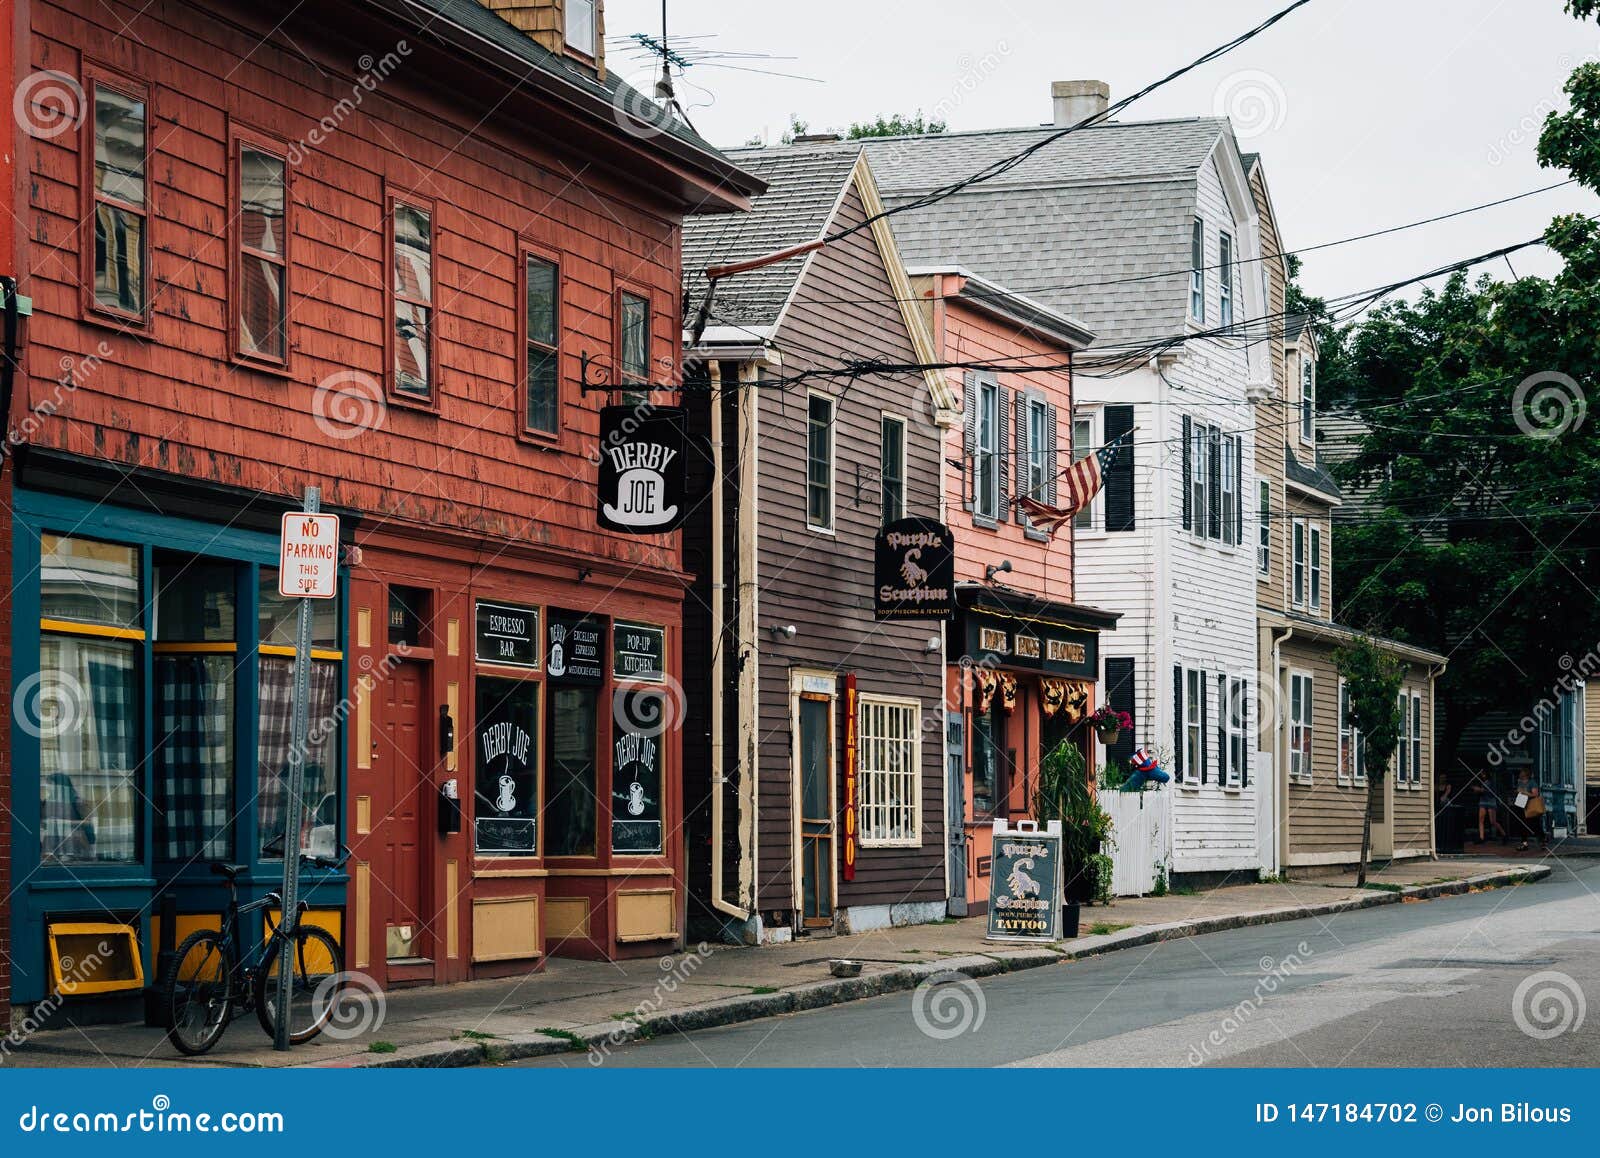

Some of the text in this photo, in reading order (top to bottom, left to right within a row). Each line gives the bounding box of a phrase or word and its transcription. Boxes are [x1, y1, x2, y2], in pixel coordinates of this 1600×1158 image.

[609, 442, 677, 473] DERBY
[624, 480, 655, 513] JOE
[302, 522, 319, 537] NO
[886, 532, 941, 551] Purple
[287, 543, 332, 559] PARKING
[299, 564, 319, 575] THIS
[298, 578, 318, 590] SIDE
[880, 585, 948, 604] Scorpion
[489, 614, 525, 635] ESPRESSO
[573, 630, 599, 645] EXCELLENT
[626, 634, 651, 652] POP-UP
[499, 640, 515, 657] BAR
[575, 644, 596, 656] ESPRESSO
[624, 657, 653, 674] KITCHEN
[482, 722, 530, 766] DERBY JOE
[615, 732, 656, 772] DERBY JOE
[846, 687, 855, 865] TATTOO
[995, 920, 1047, 930] TATTOO
